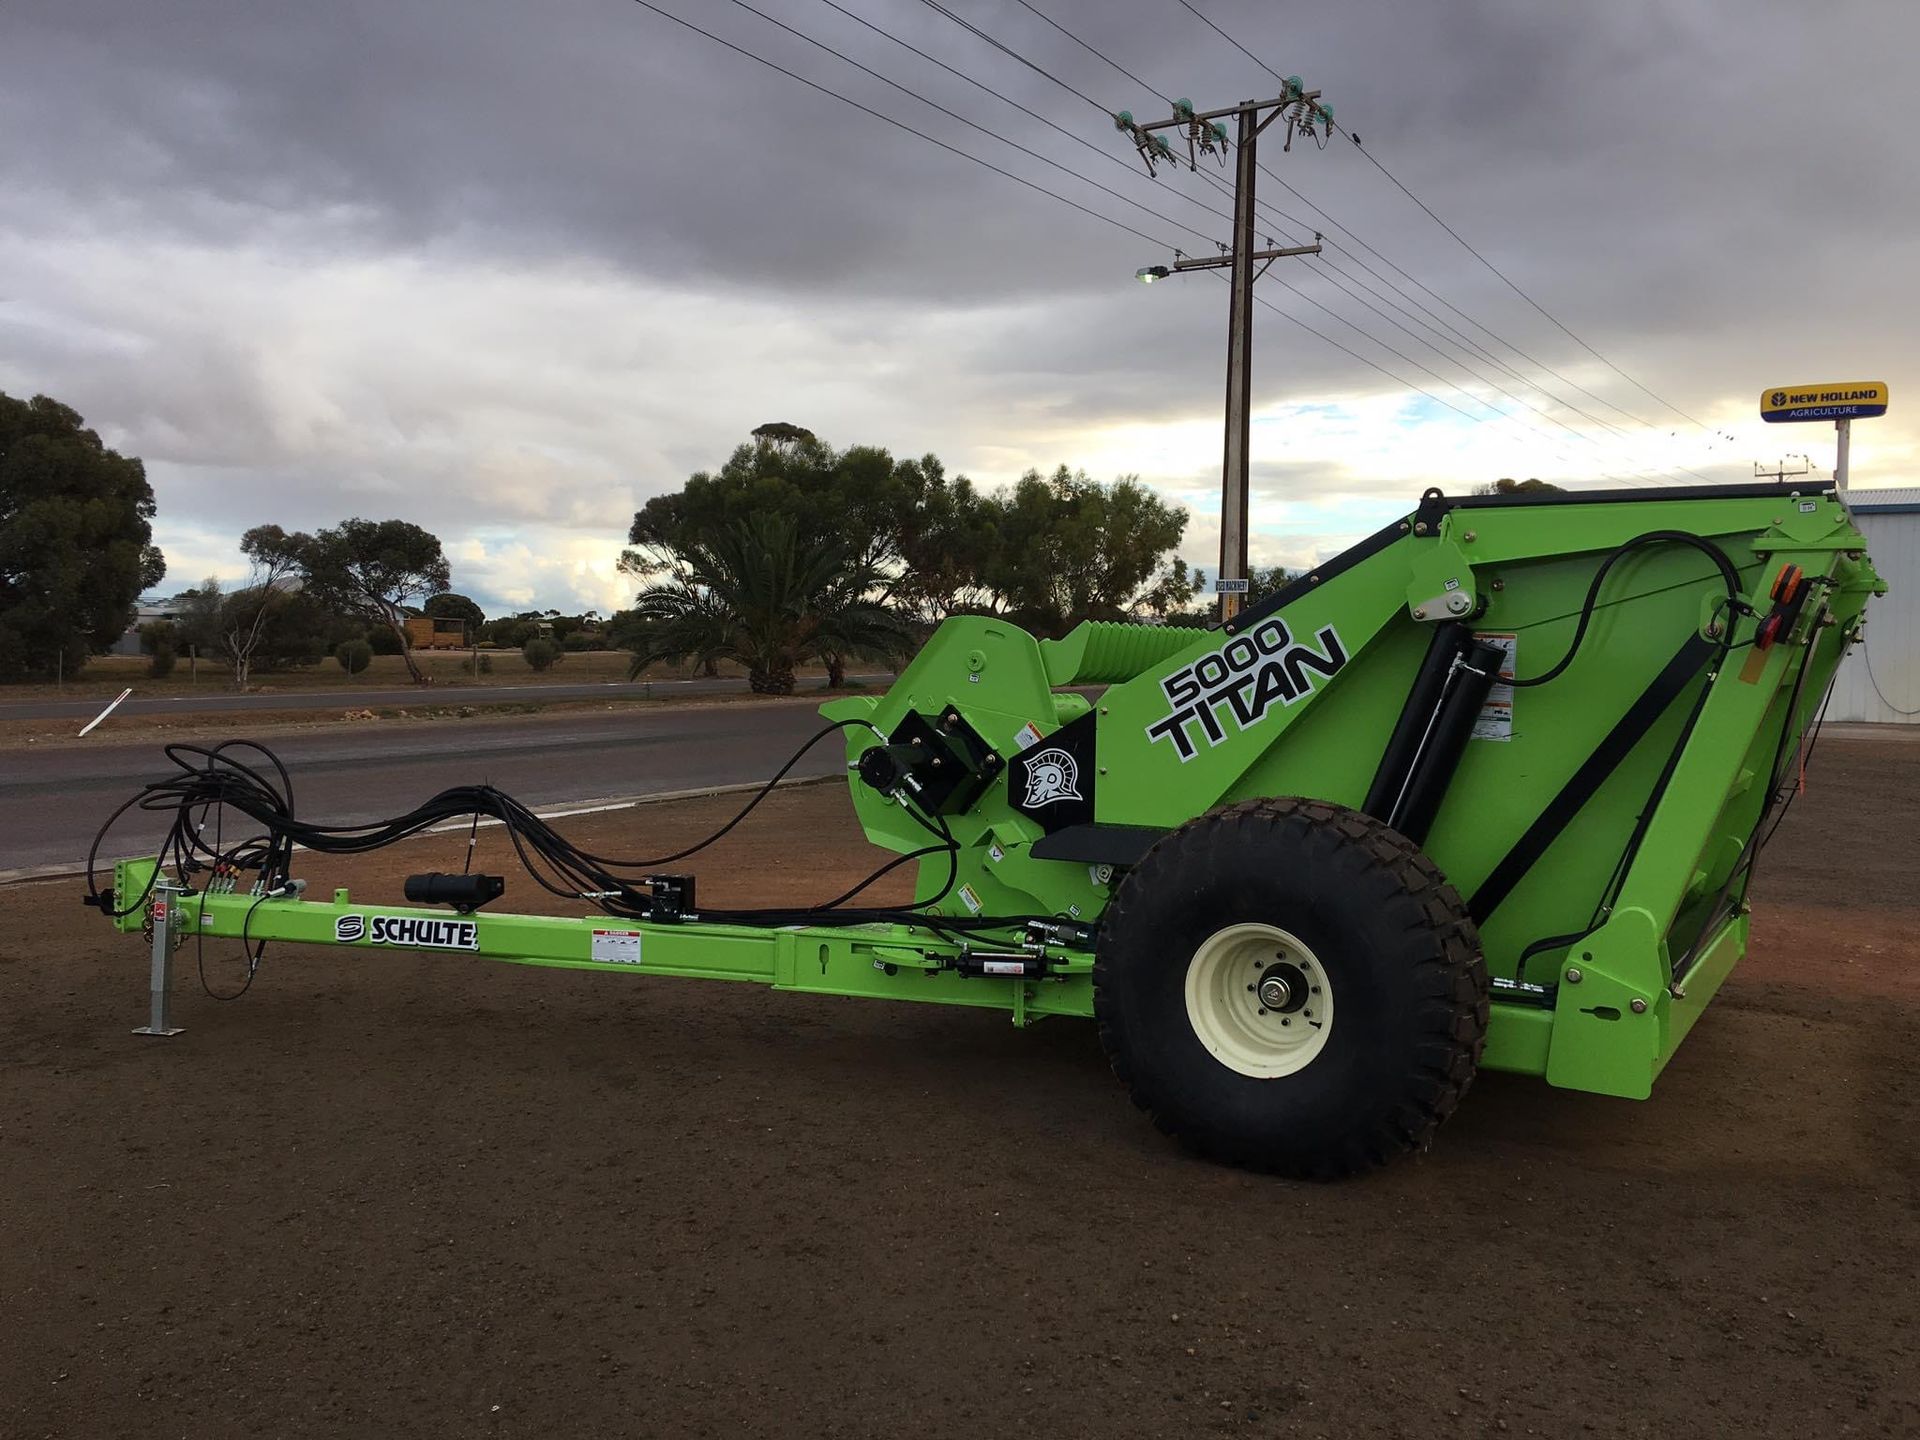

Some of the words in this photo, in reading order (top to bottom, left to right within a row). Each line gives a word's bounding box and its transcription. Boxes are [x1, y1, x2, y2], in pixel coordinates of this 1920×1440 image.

[1790, 394, 1818, 403] NEW
[1820, 390, 1877, 402] HOLLAND
[1790, 406, 1857, 417] AGRICULTURE
[1163, 620, 1290, 709] 5000
[1149, 628, 1346, 758] TITAN
[371, 917, 475, 947] SCHULTE
